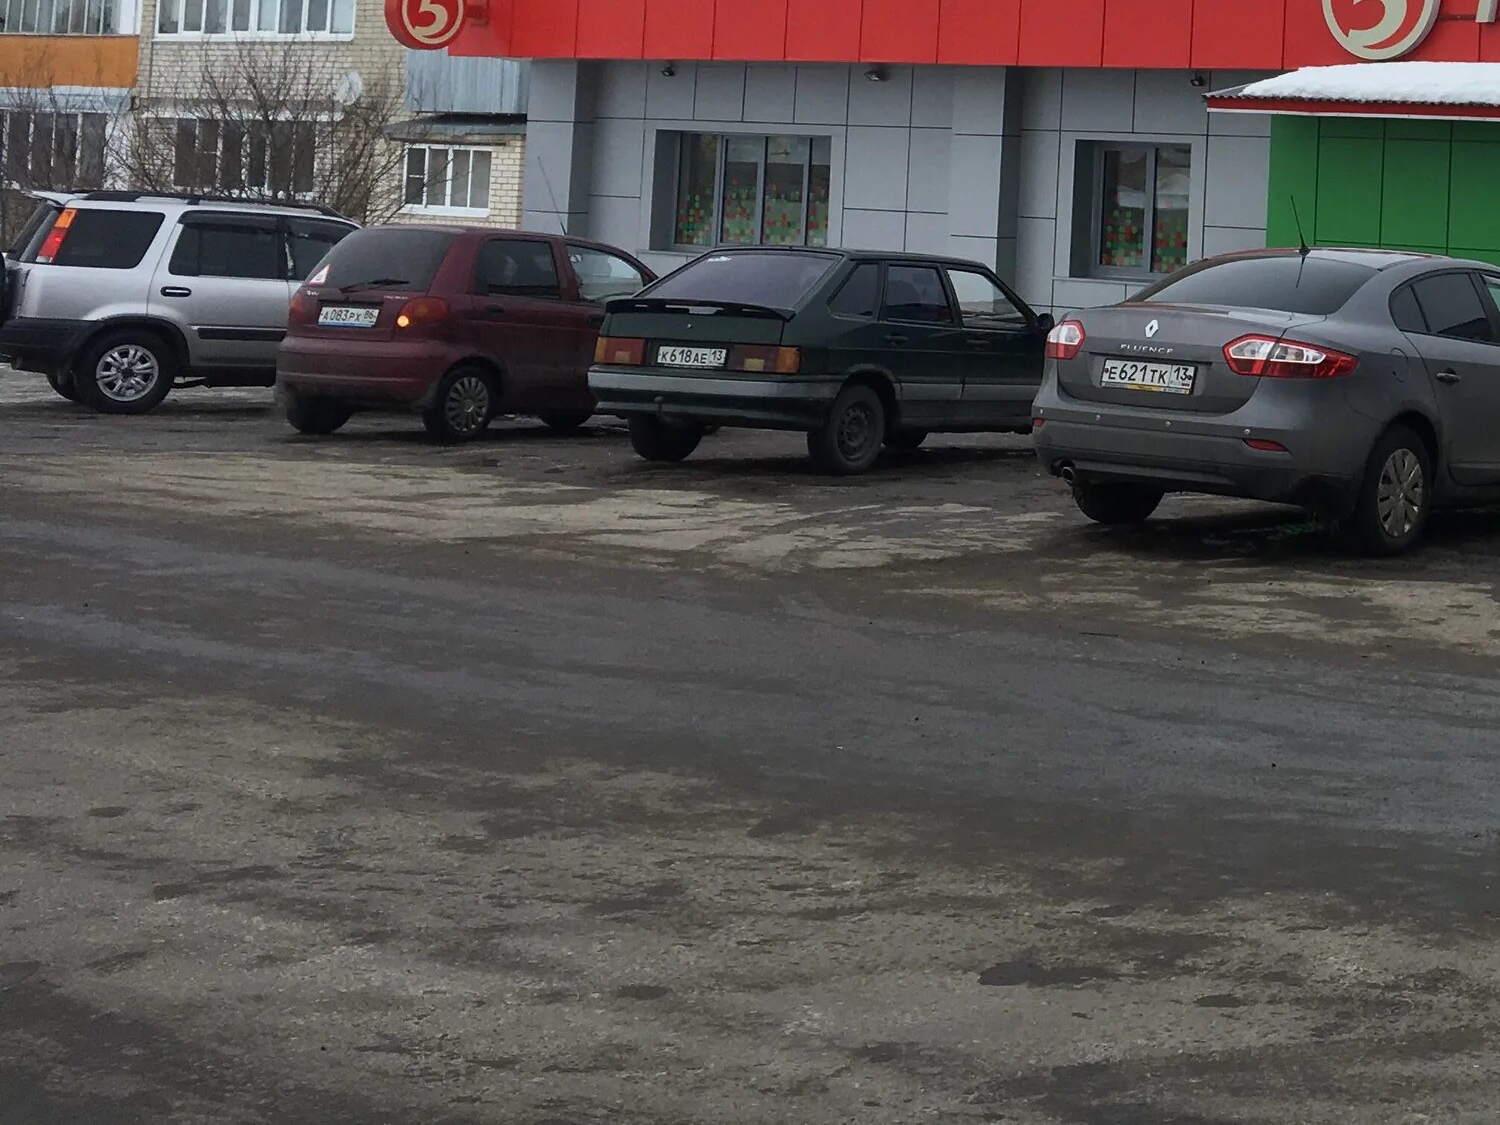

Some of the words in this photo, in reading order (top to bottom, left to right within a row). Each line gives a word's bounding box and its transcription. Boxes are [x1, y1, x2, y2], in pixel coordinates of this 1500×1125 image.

[1120, 343, 1174, 354] FLUENCE
[660, 349, 707, 364] К618АЕ
[711, 350, 722, 361] 13
[1108, 364, 1168, 384] Е621ТК
[1174, 367, 1188, 381] 13
